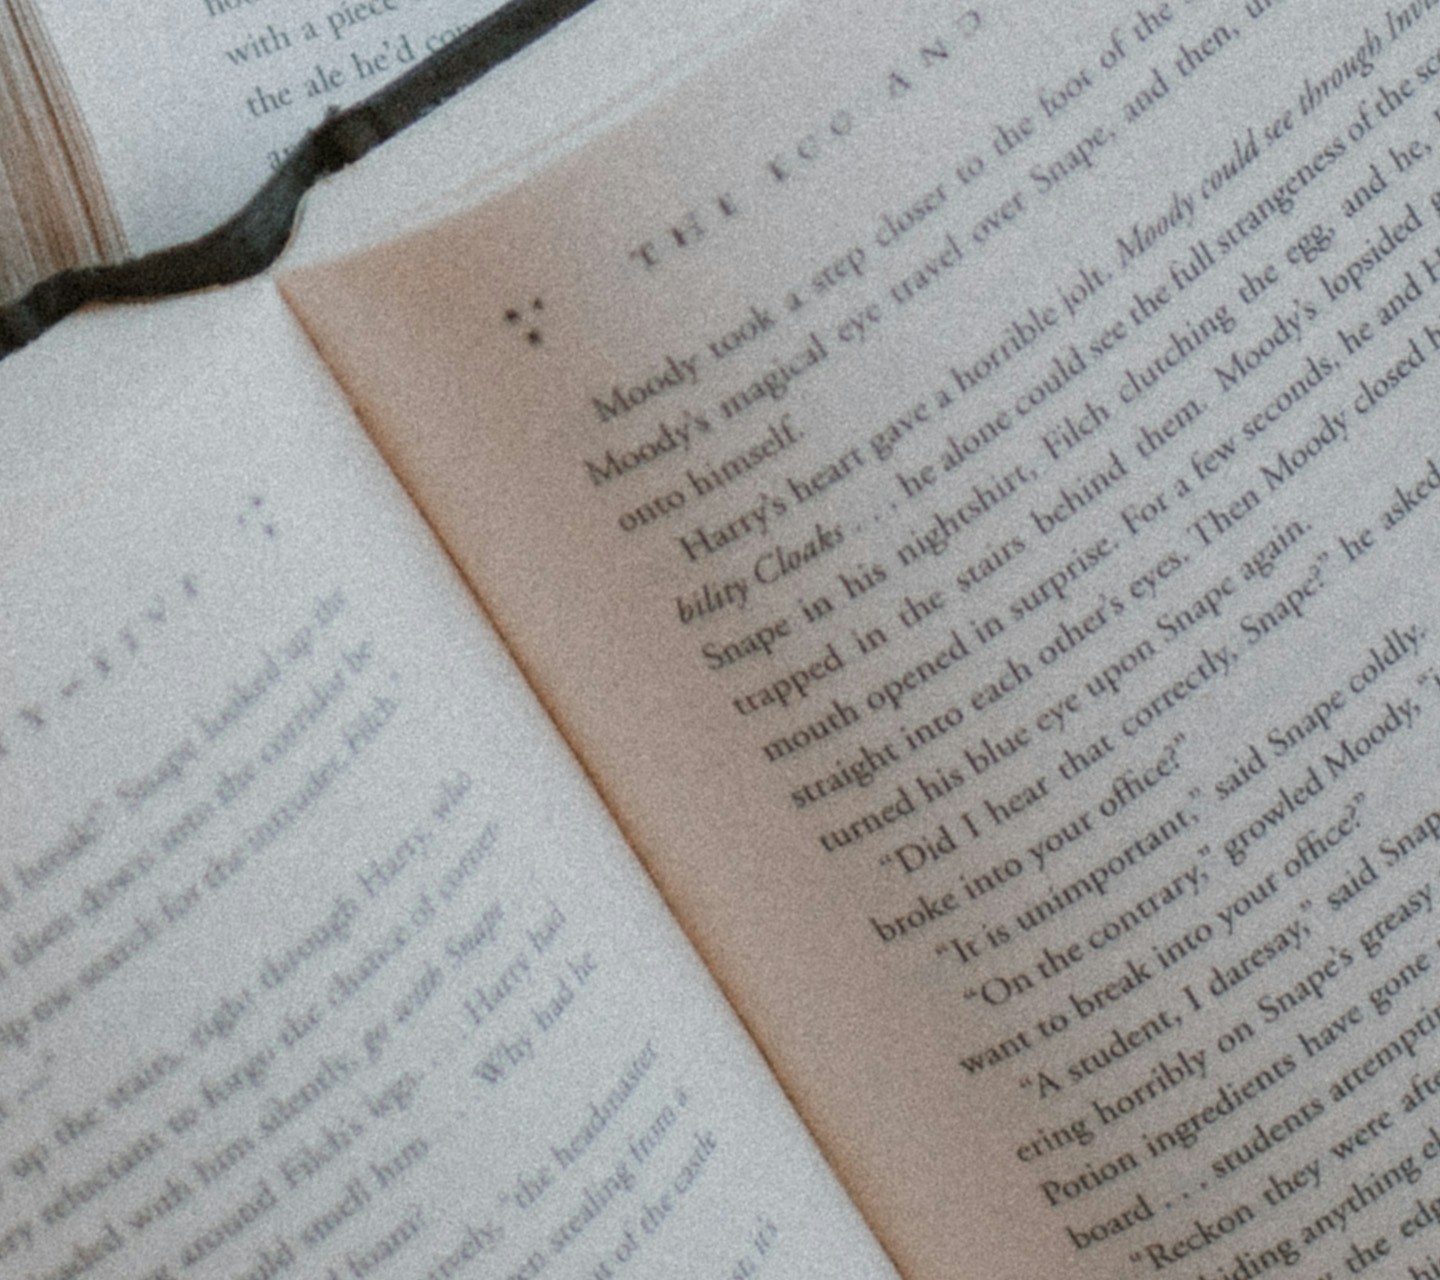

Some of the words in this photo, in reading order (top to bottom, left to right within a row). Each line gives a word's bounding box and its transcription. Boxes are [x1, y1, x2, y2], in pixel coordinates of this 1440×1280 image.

[587, 354, 700, 424] Moody
[706, 304, 778, 361] took
[784, 289, 807, 315] a
[809, 244, 868, 297] step
[873, 182, 949, 249] closer
[953, 154, 987, 187] to
[990, 114, 1035, 159] the
[1035, 67, 1094, 121] foot
[1098, 24, 1128, 72] of
[1130, 0, 1175, 44] the
[867, 891, 960, 945] broke
[959, 856, 1025, 901] into
[1026, 811, 1094, 872] your
[1096, 730, 1186, 818] office?”
